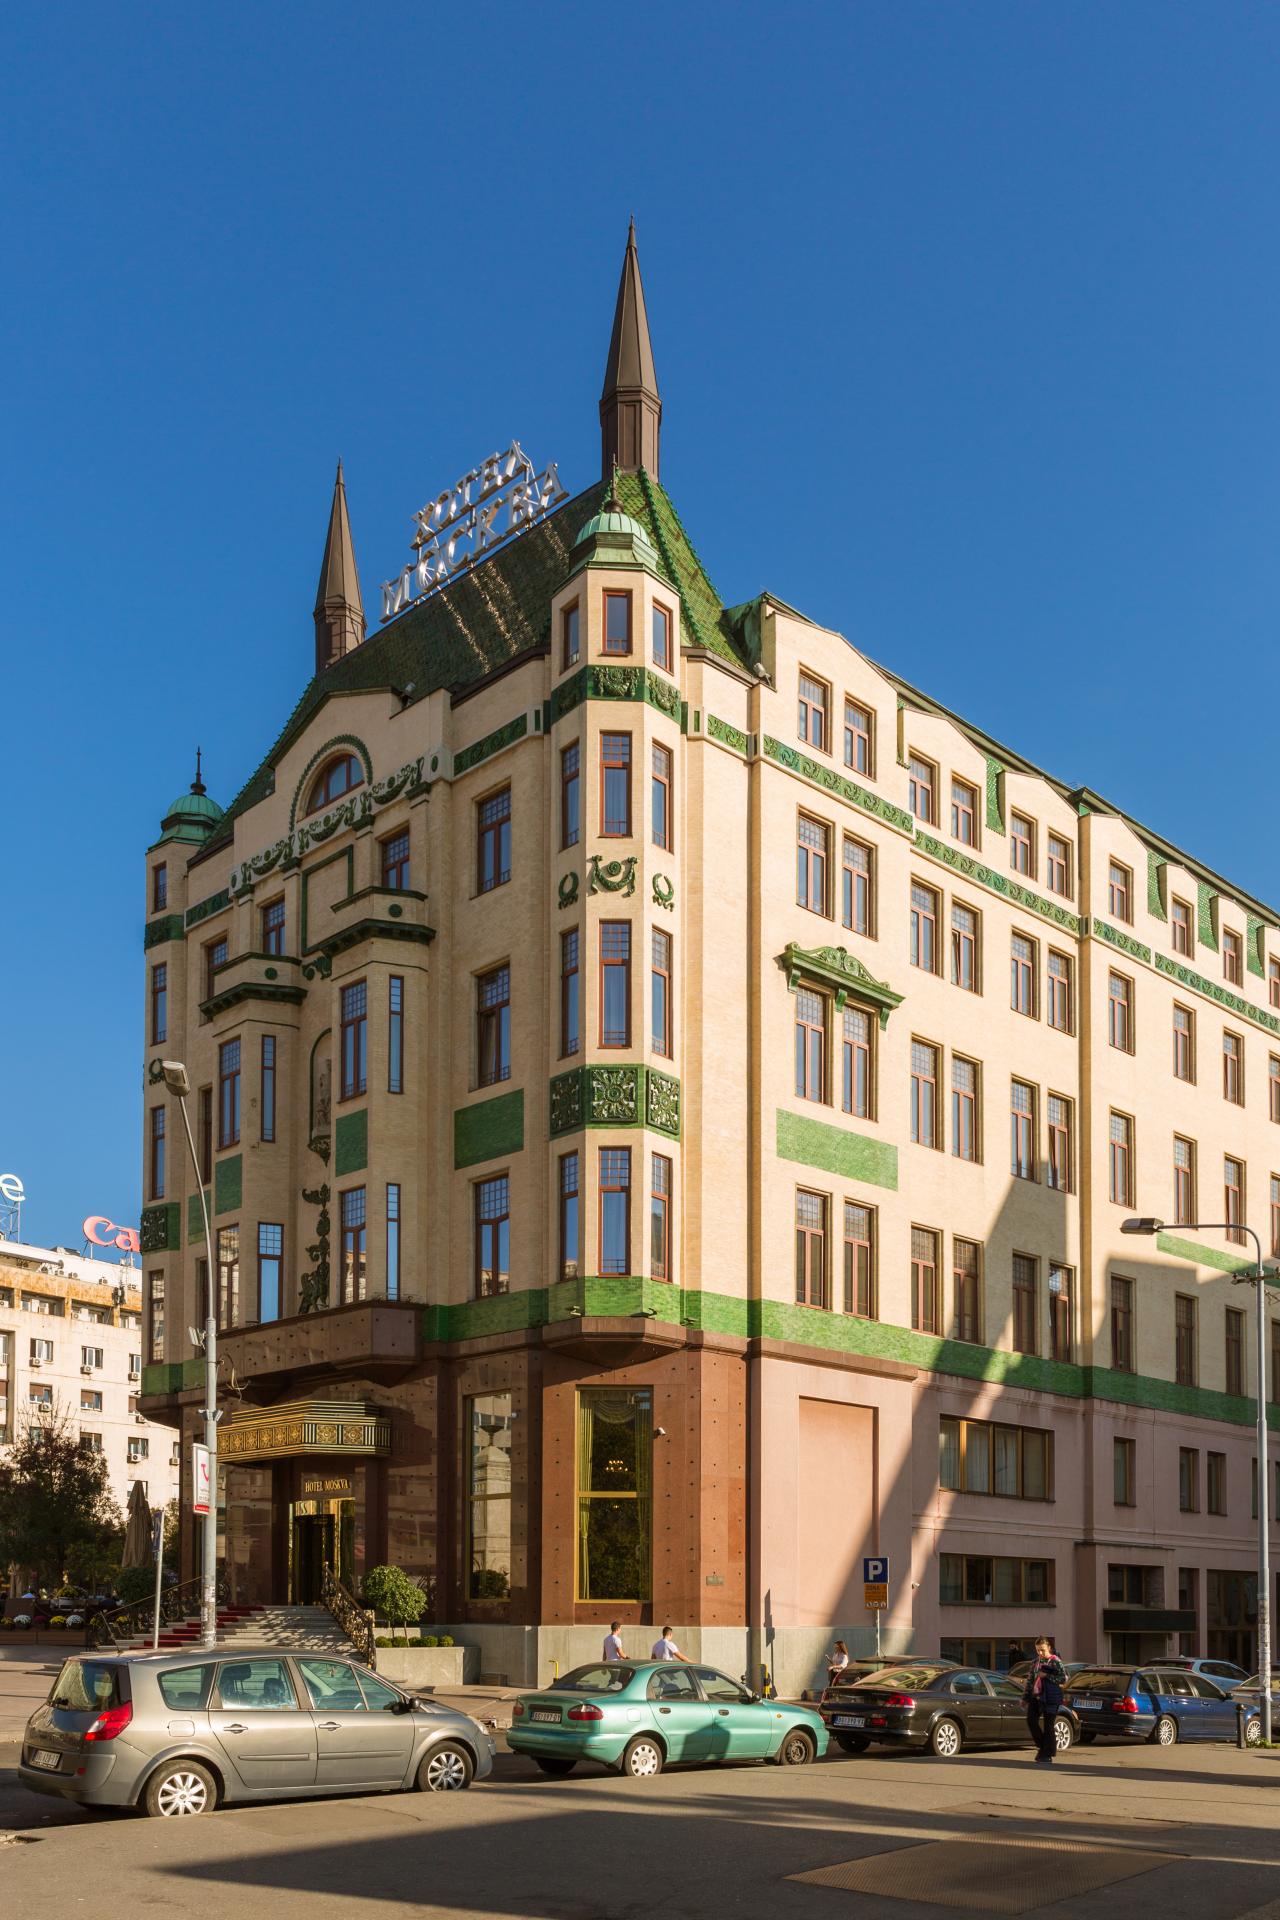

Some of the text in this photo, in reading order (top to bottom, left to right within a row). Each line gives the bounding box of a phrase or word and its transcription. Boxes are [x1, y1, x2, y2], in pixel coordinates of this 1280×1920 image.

[411, 440, 531, 550] ХОТЕЛ
[379, 463, 570, 624] МОСКВА
[305, 1479, 349, 1493] HOTEL MOSKVA
[868, 1560, 883, 1581] P
